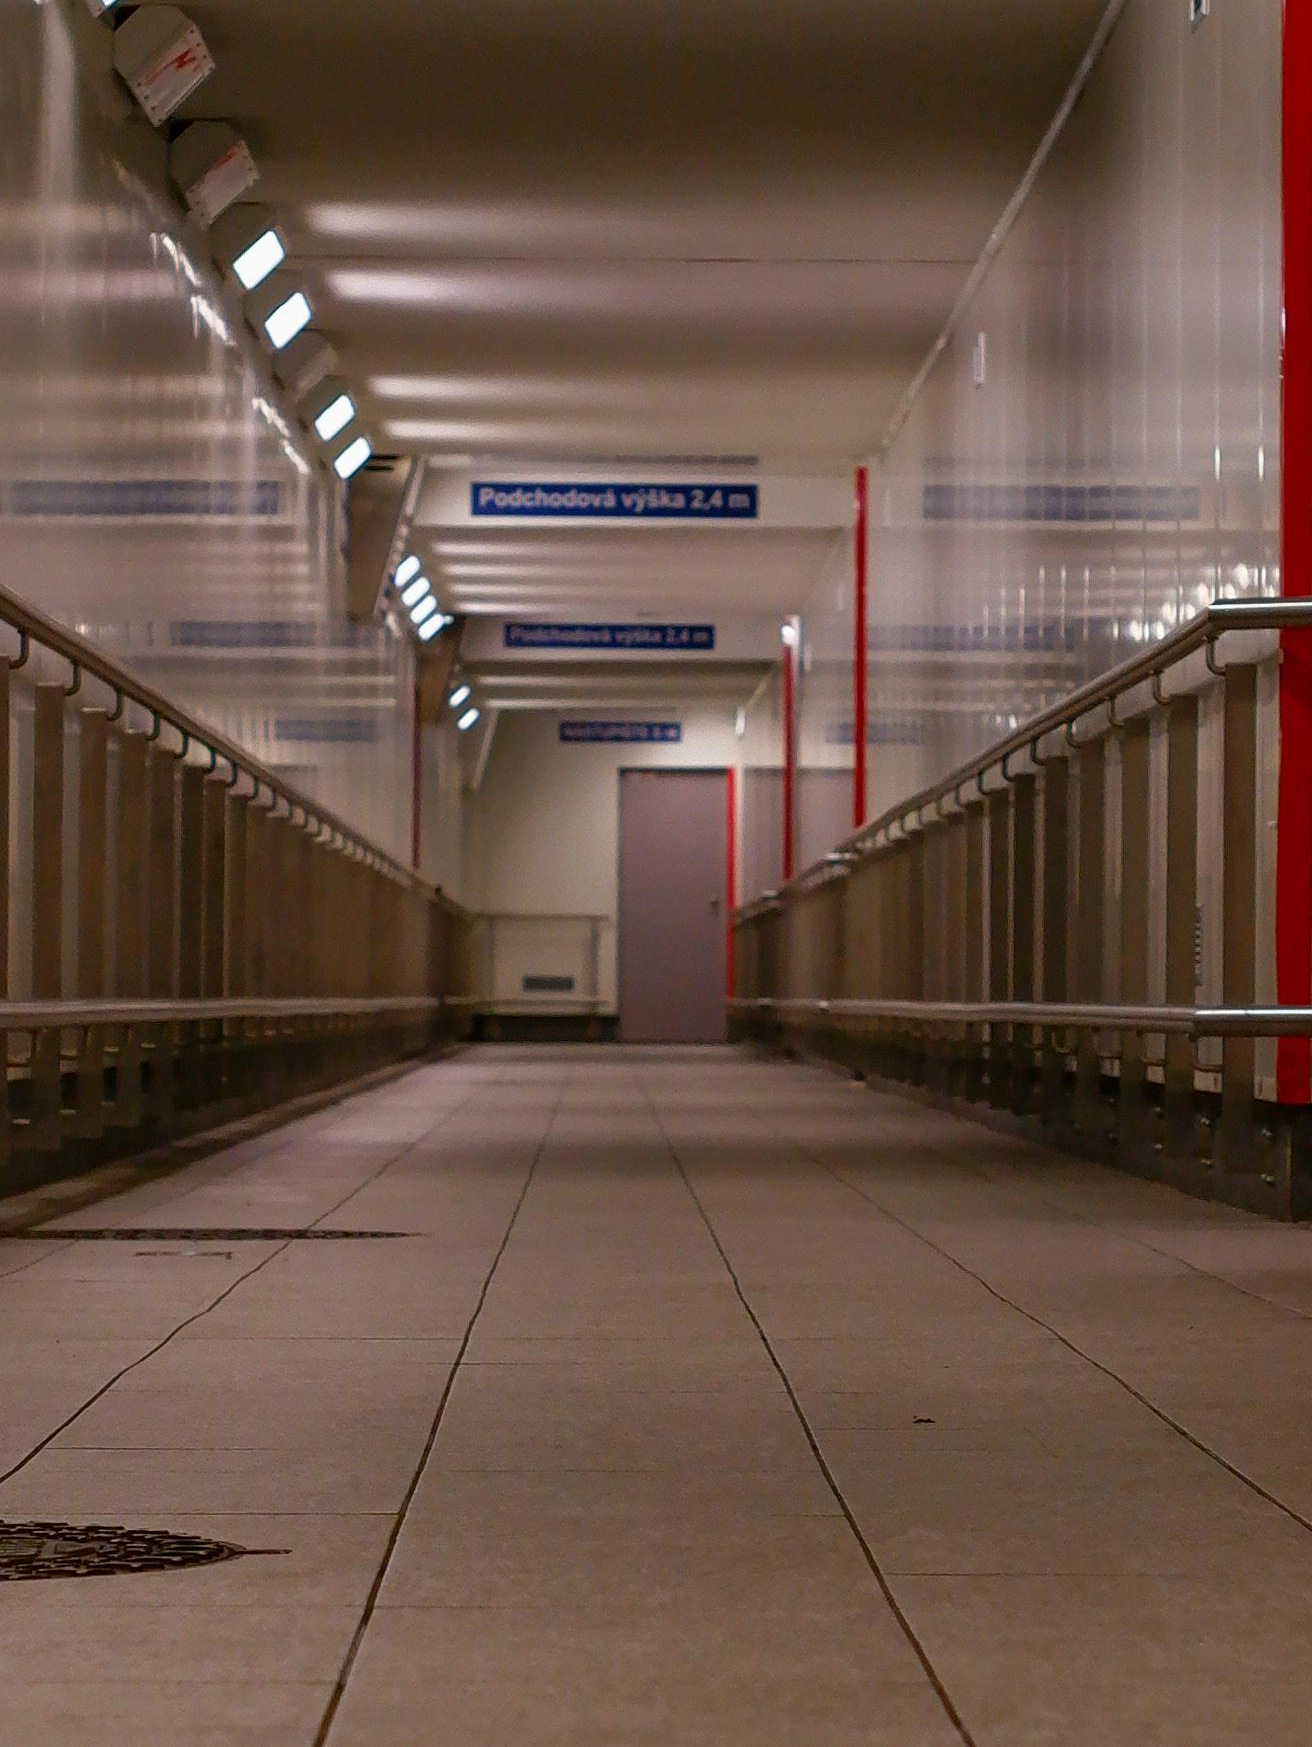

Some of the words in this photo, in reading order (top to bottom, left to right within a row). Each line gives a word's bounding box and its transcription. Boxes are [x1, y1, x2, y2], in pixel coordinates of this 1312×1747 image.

[479, 487, 616, 508] Podchodová
[620, 488, 686, 514] výška
[689, 488, 724, 511] 2,4
[727, 492, 751, 509] m
